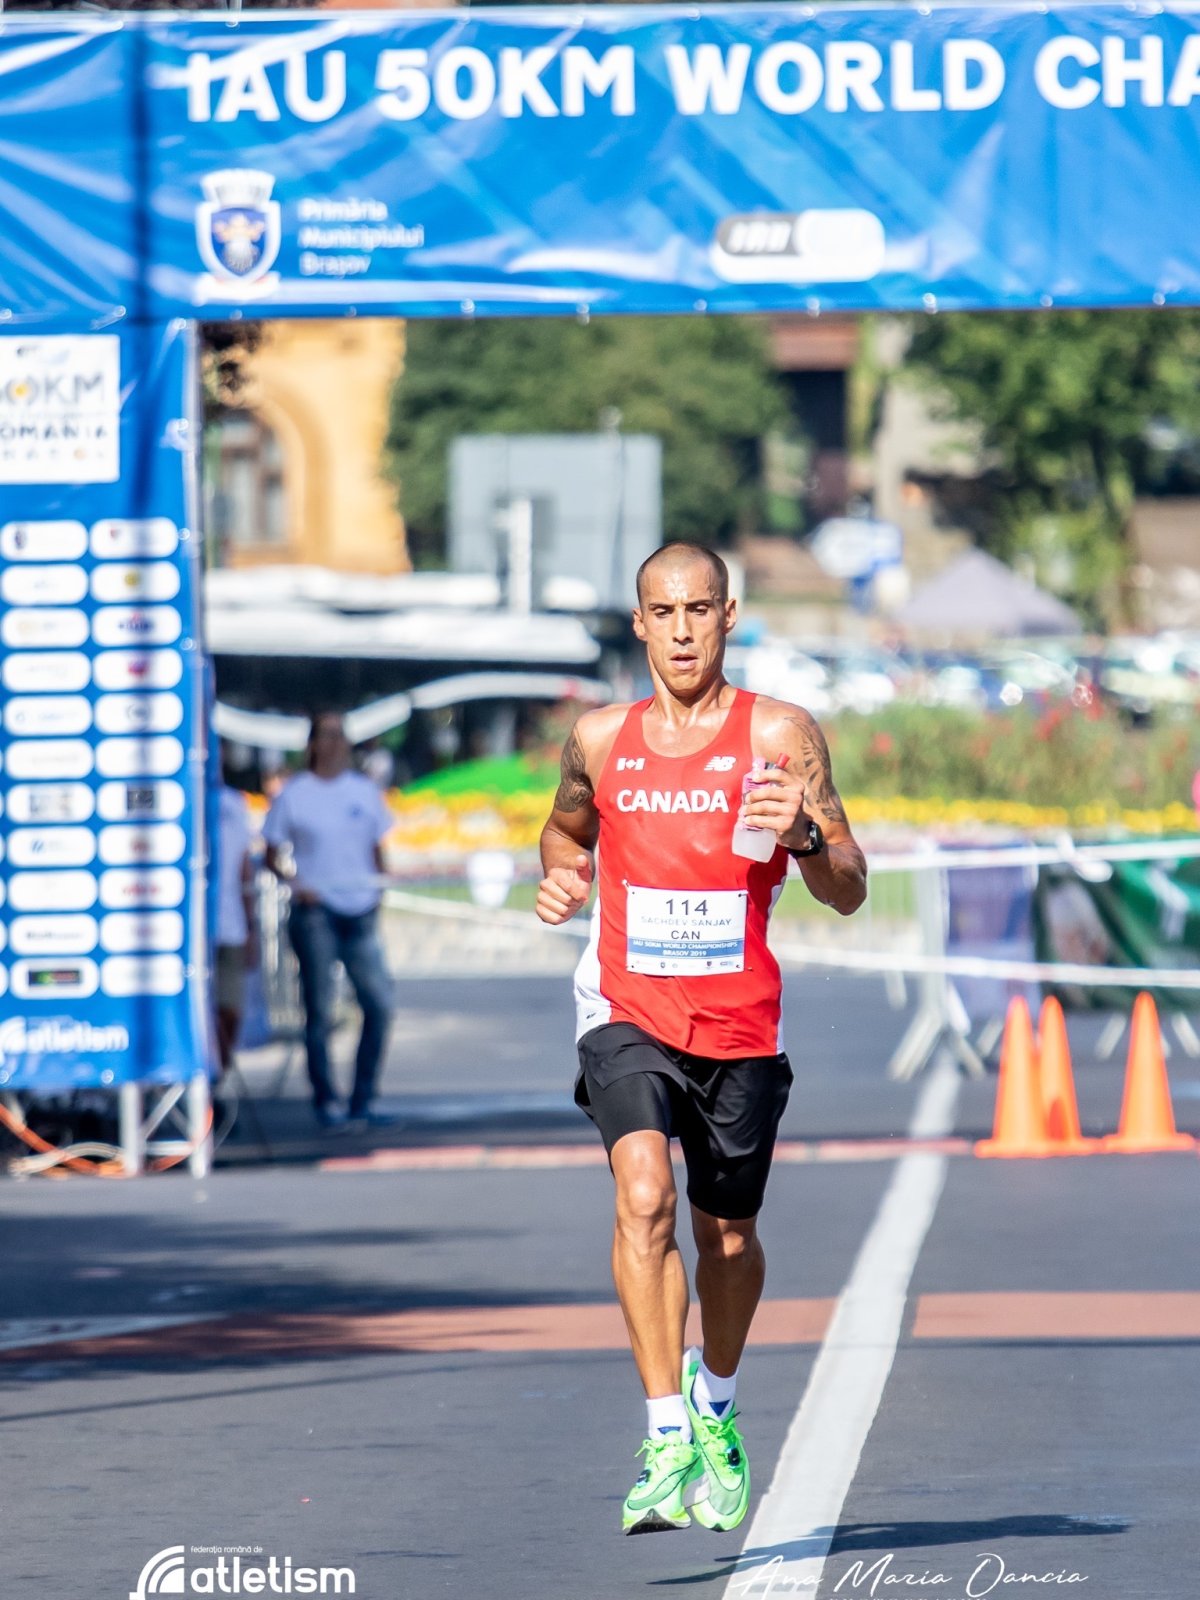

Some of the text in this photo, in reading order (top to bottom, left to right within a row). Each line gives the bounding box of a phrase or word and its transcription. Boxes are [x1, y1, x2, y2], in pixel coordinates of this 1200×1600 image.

[186, 49, 348, 123] IAU
[376, 46, 636, 121] 50KM
[664, 39, 1006, 115] WORLD
[616, 789, 729, 813] CANADA
[665, 898, 708, 916] 114
[691, 918, 732, 927] SANJAY
[670, 930, 701, 940] CAN
